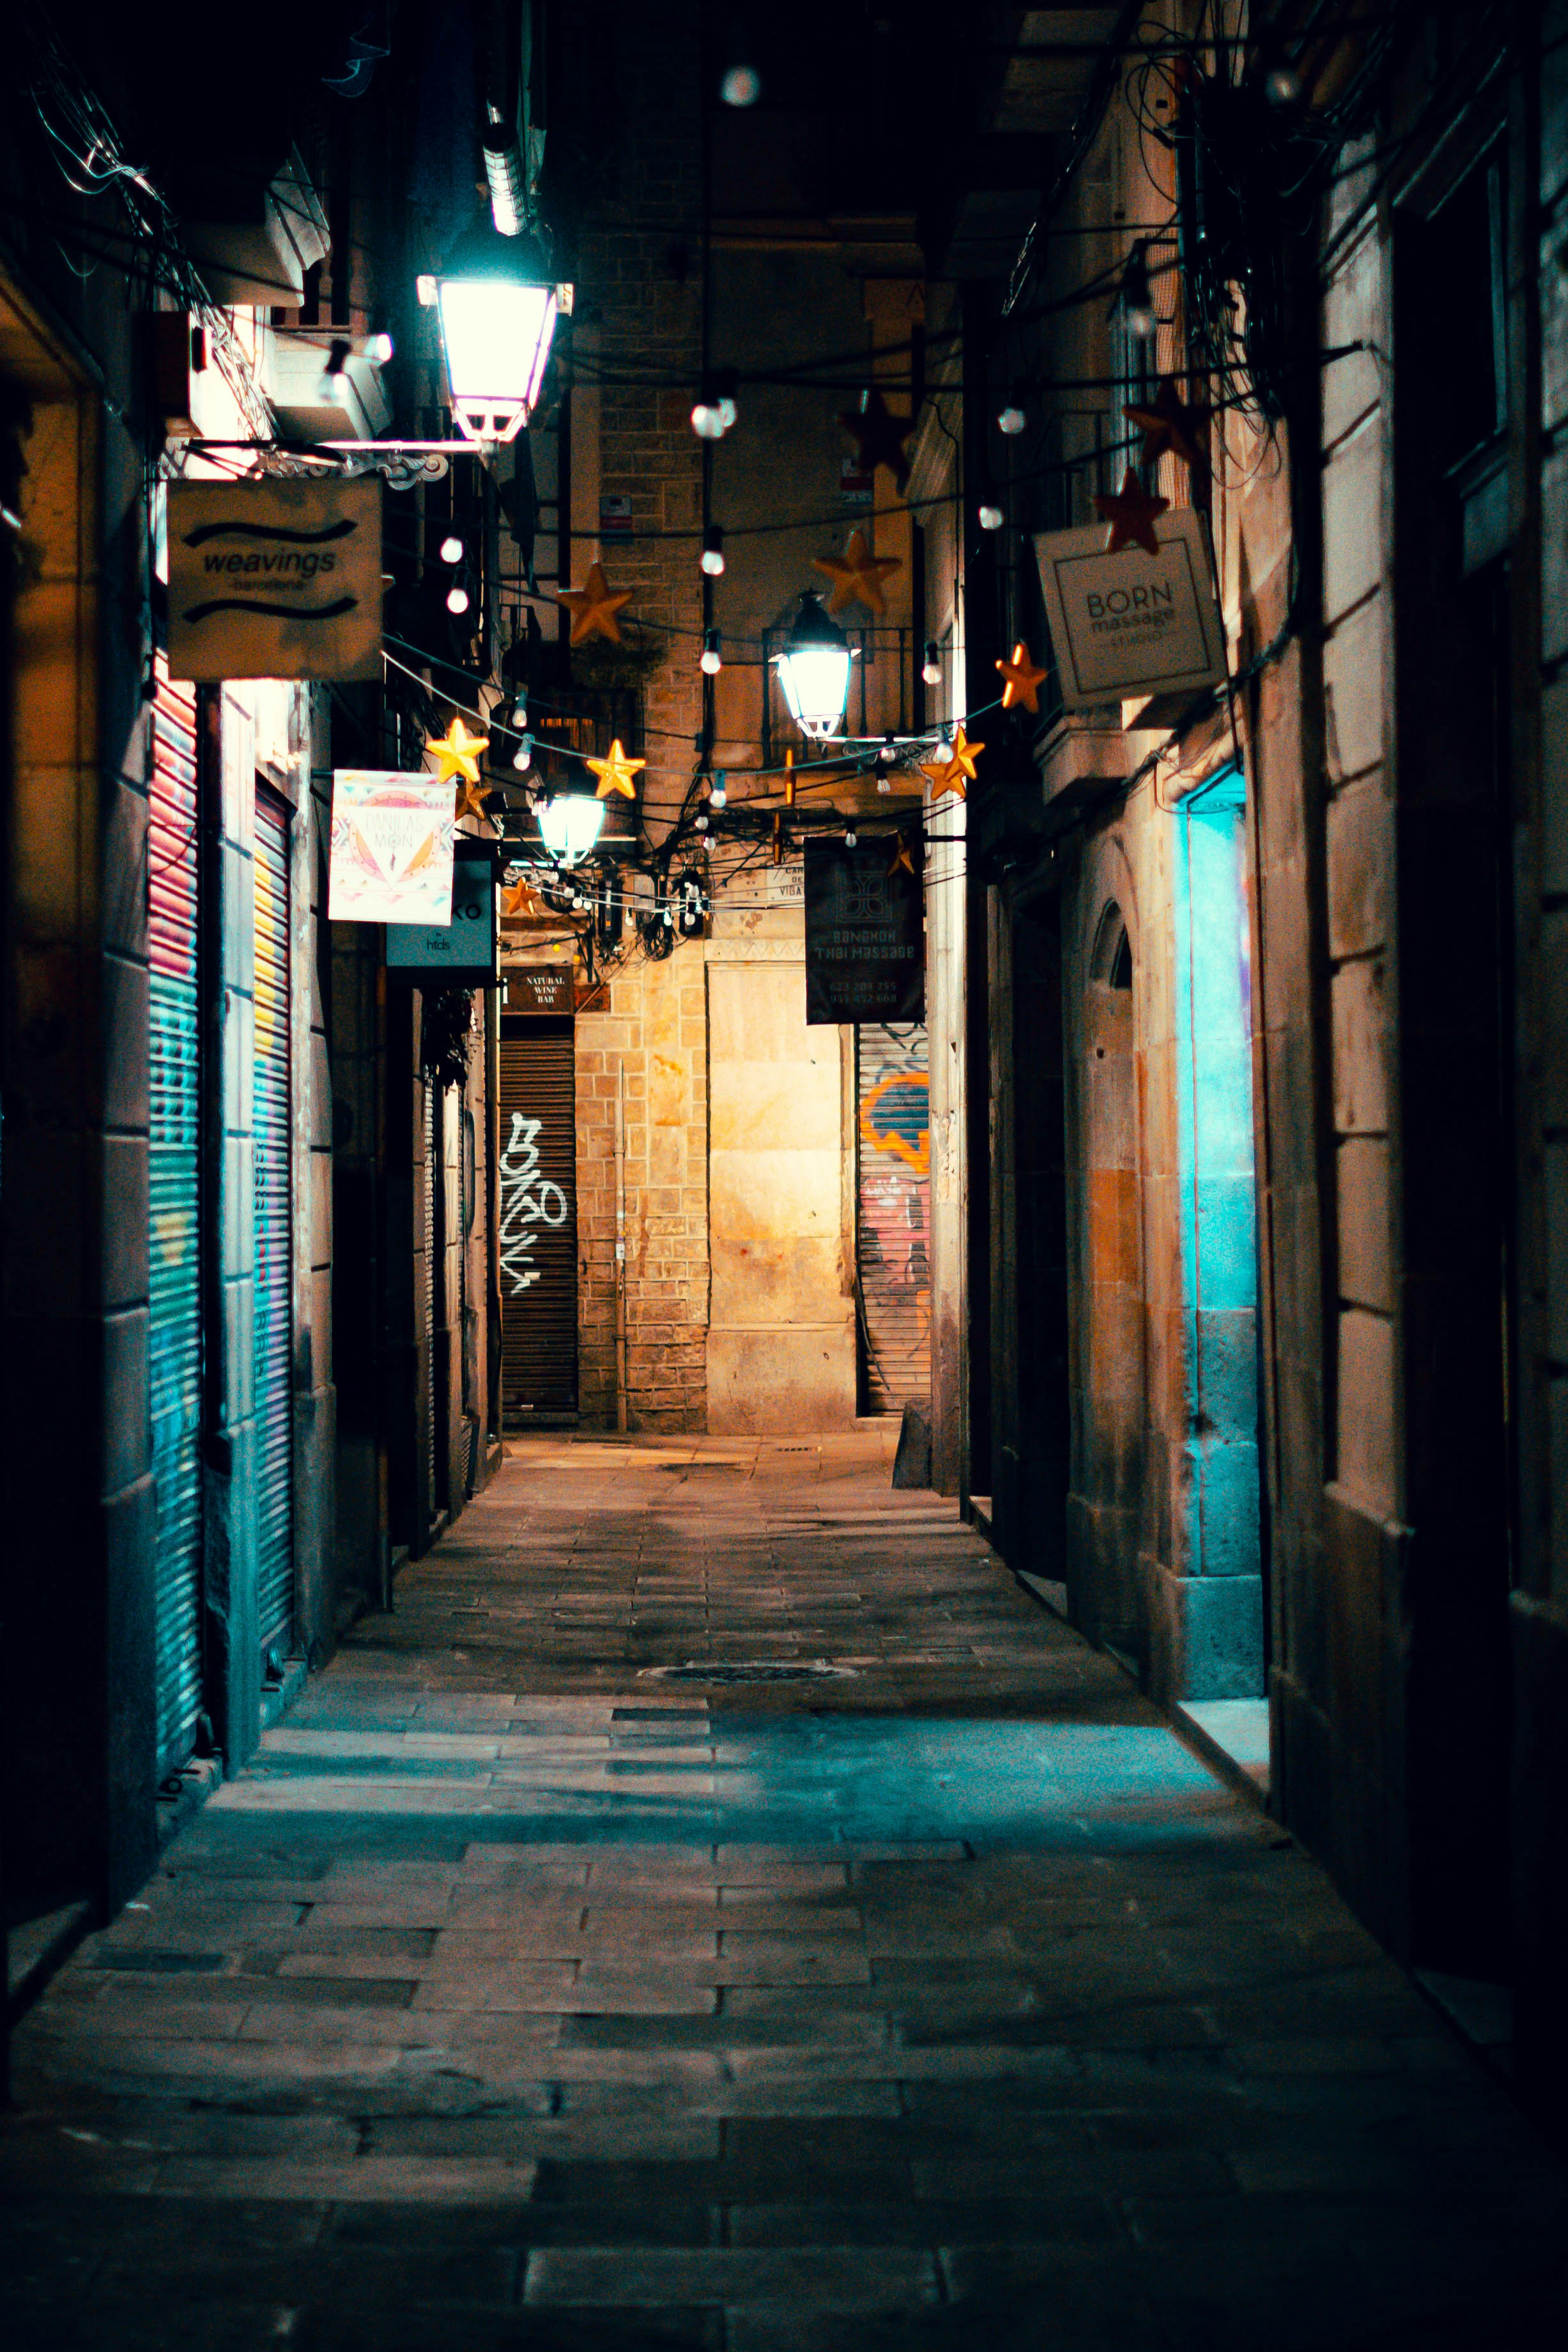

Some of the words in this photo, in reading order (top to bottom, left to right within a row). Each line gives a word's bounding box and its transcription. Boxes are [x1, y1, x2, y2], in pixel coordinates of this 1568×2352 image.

[204, 547, 335, 578] weavings
[1086, 581, 1172, 619] BORN
[1091, 607, 1176, 633] massage
[527, 976, 565, 985] NATURAL
[534, 986, 558, 994] WINE
[537, 995, 555, 1003] BAR
